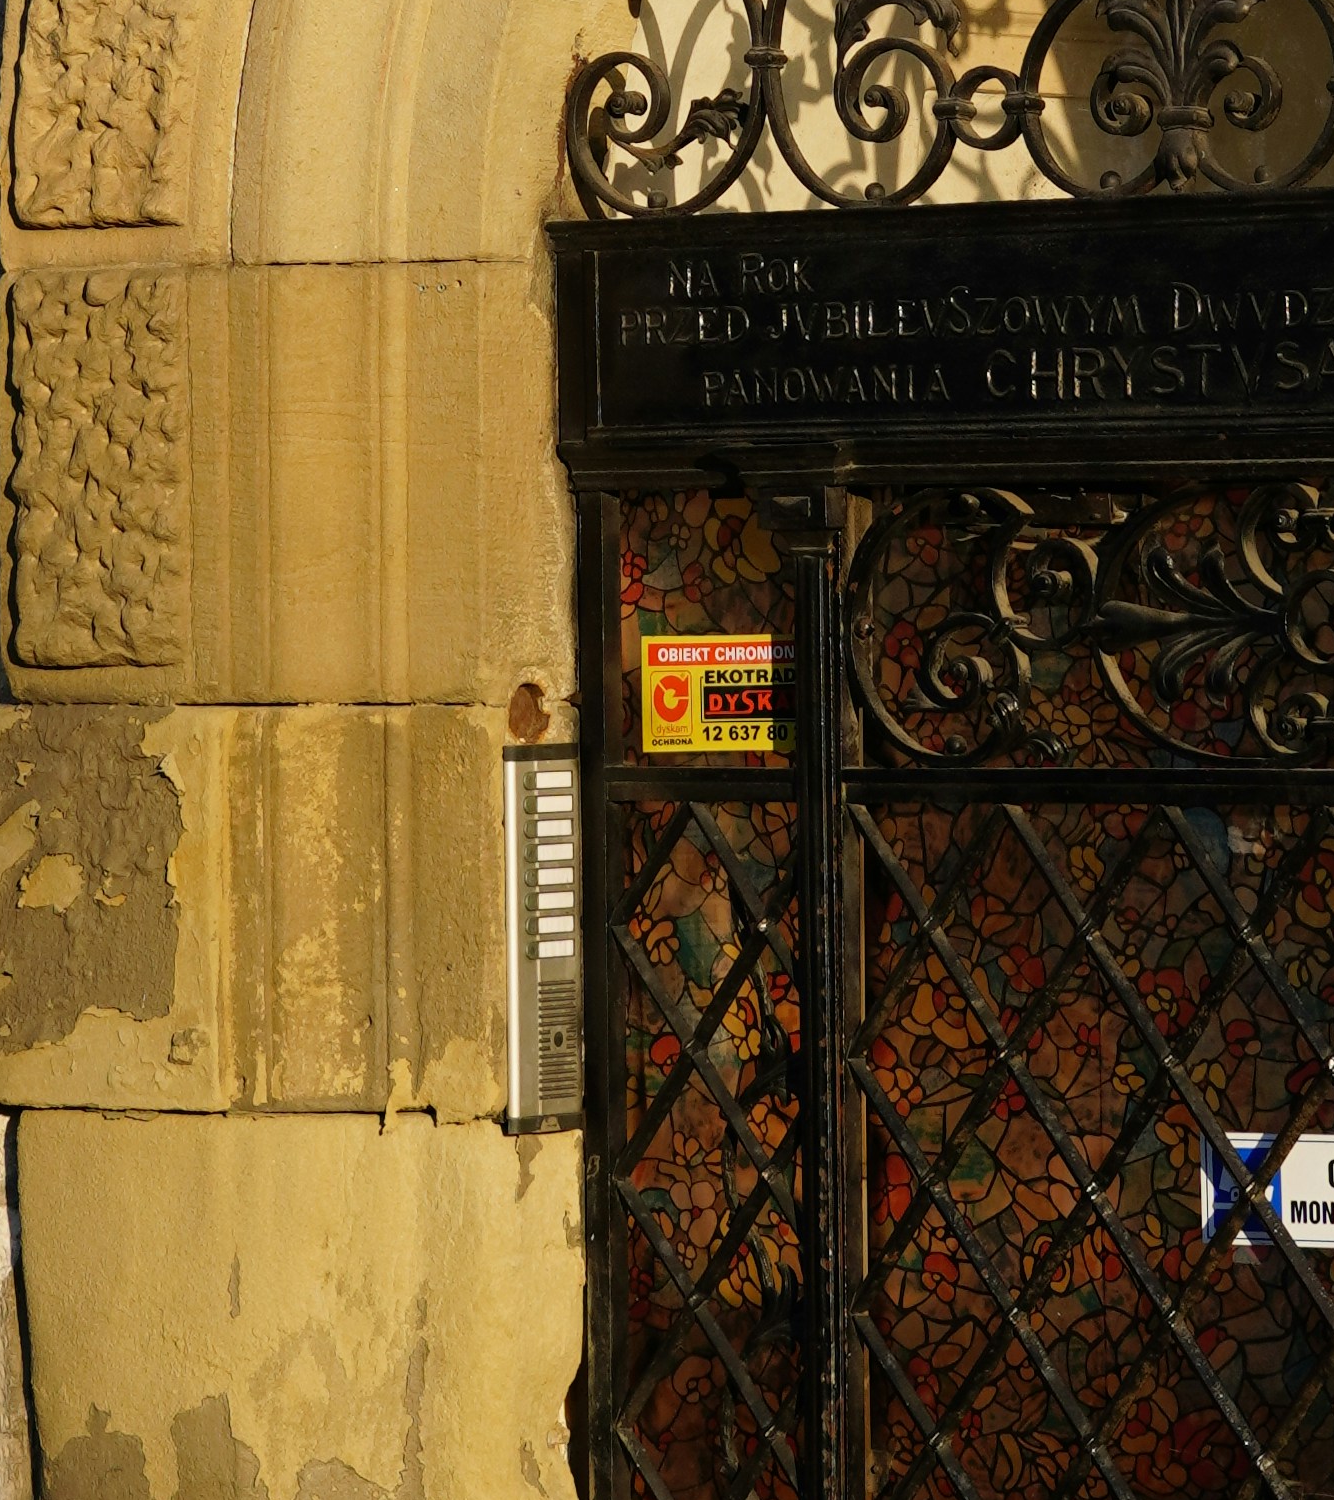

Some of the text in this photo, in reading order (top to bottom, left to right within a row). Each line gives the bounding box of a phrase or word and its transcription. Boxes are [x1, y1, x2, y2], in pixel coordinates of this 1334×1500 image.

[667, 251, 815, 299] NA ROK
[618, 304, 751, 346] PRZED
[702, 363, 951, 407] PANOWANIA
[657, 646, 710, 663] OBIEKT
[651, 738, 694, 746] OCHRONA
[702, 725, 723, 742] 12
[728, 725, 760, 741] 637
[767, 724, 789, 741] 80
